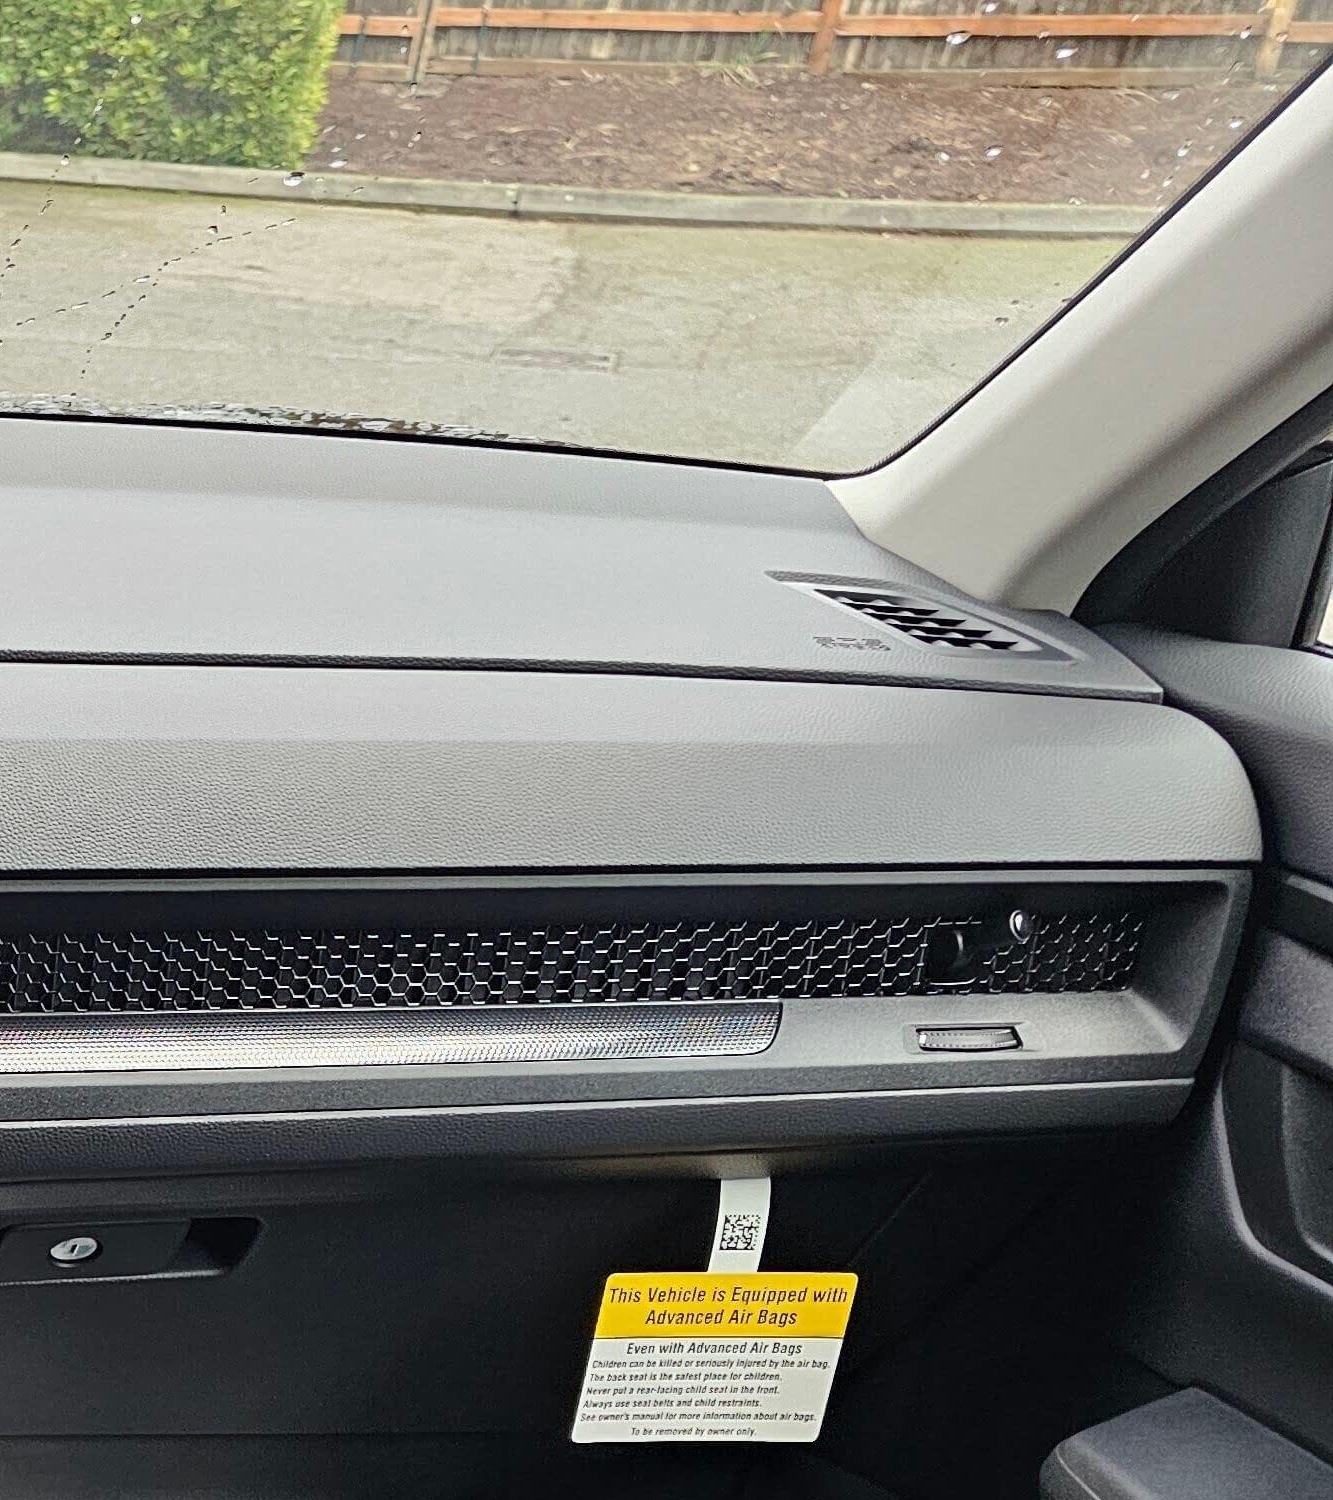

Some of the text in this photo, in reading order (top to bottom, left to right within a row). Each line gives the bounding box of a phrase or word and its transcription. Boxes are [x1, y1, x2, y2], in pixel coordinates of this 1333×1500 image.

[610, 1286, 848, 1305] This Vehicle is Equipped with
[645, 1309, 798, 1328] Advanced Air Bags
[627, 1341, 803, 1356] Even with Advanced Air Bags
[592, 1360, 627, 1368] Children
[646, 1359, 657, 1368] be
[658, 1359, 683, 1368] killed
[684, 1360, 693, 1368] or
[695, 1359, 735, 1369] seriously
[736, 1359, 766, 1369] injured
[769, 1359, 779, 1369] by
[781, 1359, 795, 1368] the
[796, 1359, 810, 1368] air
[811, 1359, 831, 1370] bag.
[590, 1372, 783, 1382] The back seat is the safest place for children.
[586, 1385, 780, 1396] Never put rear-facing child seat in the front.
[583, 1400, 613, 1410] Always
[633, 1399, 652, 1408] seat
[653, 1399, 674, 1408] belts
[676, 1399, 693, 1408] and
[694, 1399, 717, 1407] child
[718, 1399, 762, 1408] restraints.
[580, 1412, 817, 1422] See owner's manual for more information about air bags.
[630, 1427, 757, 1437] To be removed by owner only.
